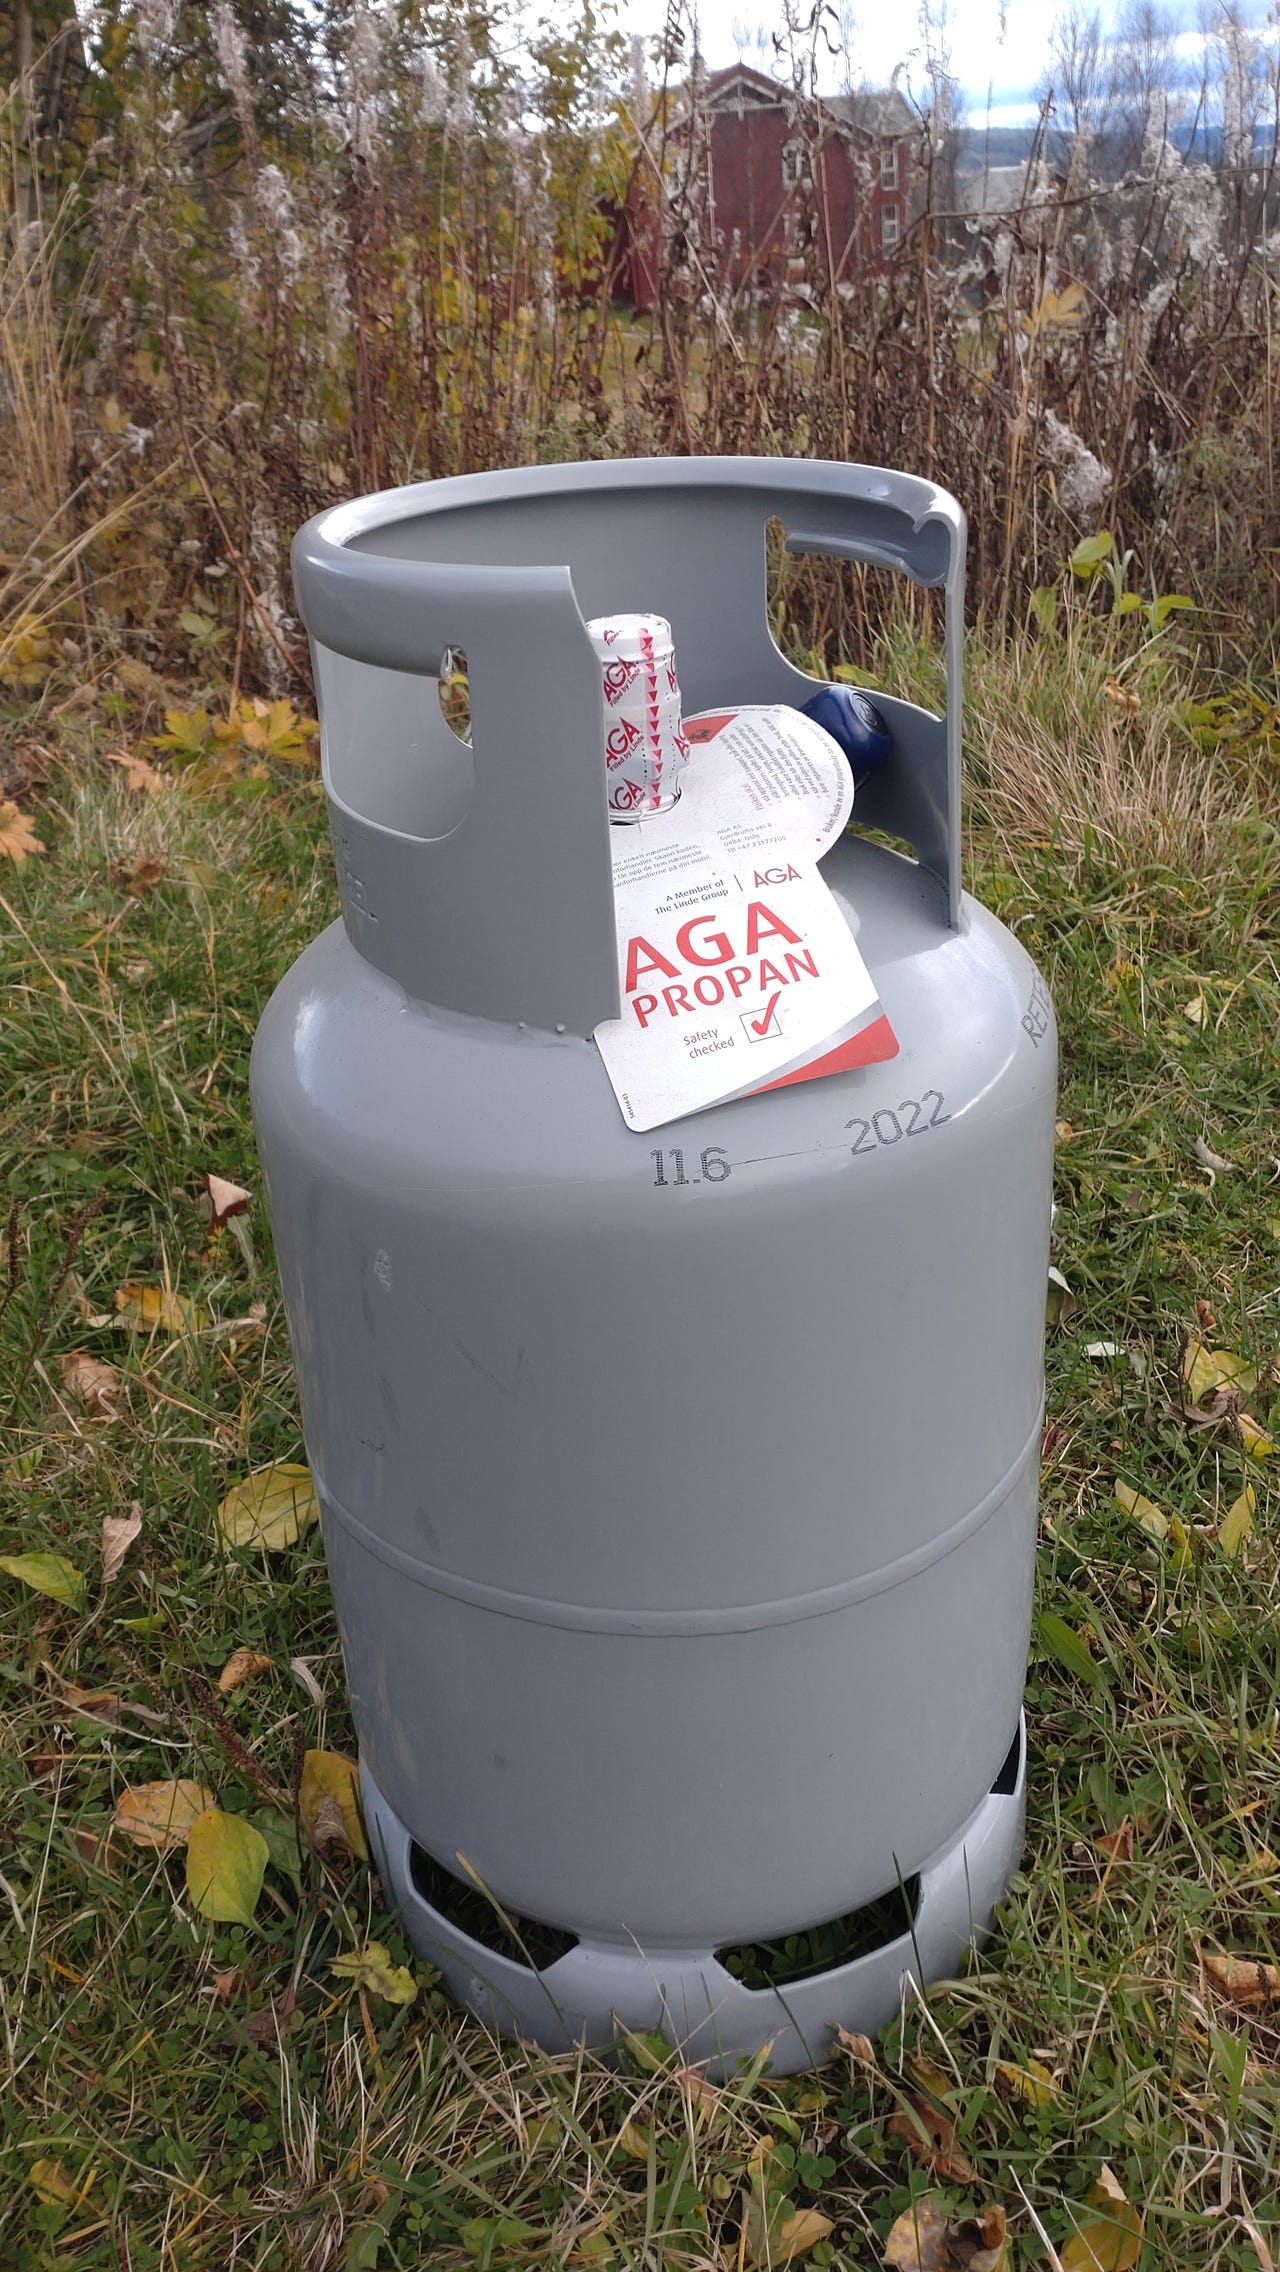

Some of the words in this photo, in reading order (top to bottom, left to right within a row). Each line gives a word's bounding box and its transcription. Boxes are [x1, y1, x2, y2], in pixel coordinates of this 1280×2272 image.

[603, 656, 637, 702] AGA
[606, 717, 640, 768] AGA
[666, 894, 674, 902] A
[675, 882, 712, 900] Member
[714, 879, 725, 889] of
[753, 863, 802, 888] AGA
[654, 903, 672, 915] The
[673, 896, 699, 910] Linde
[700, 887, 729, 903] Group
[625, 901, 803, 994] AGA
[631, 949, 820, 1029] PROPAN
[683, 1026, 719, 1046] Safety
[689, 1036, 735, 1060] checked
[843, 1089, 953, 1156] 2022
[648, 1145, 733, 1187] 11.6
